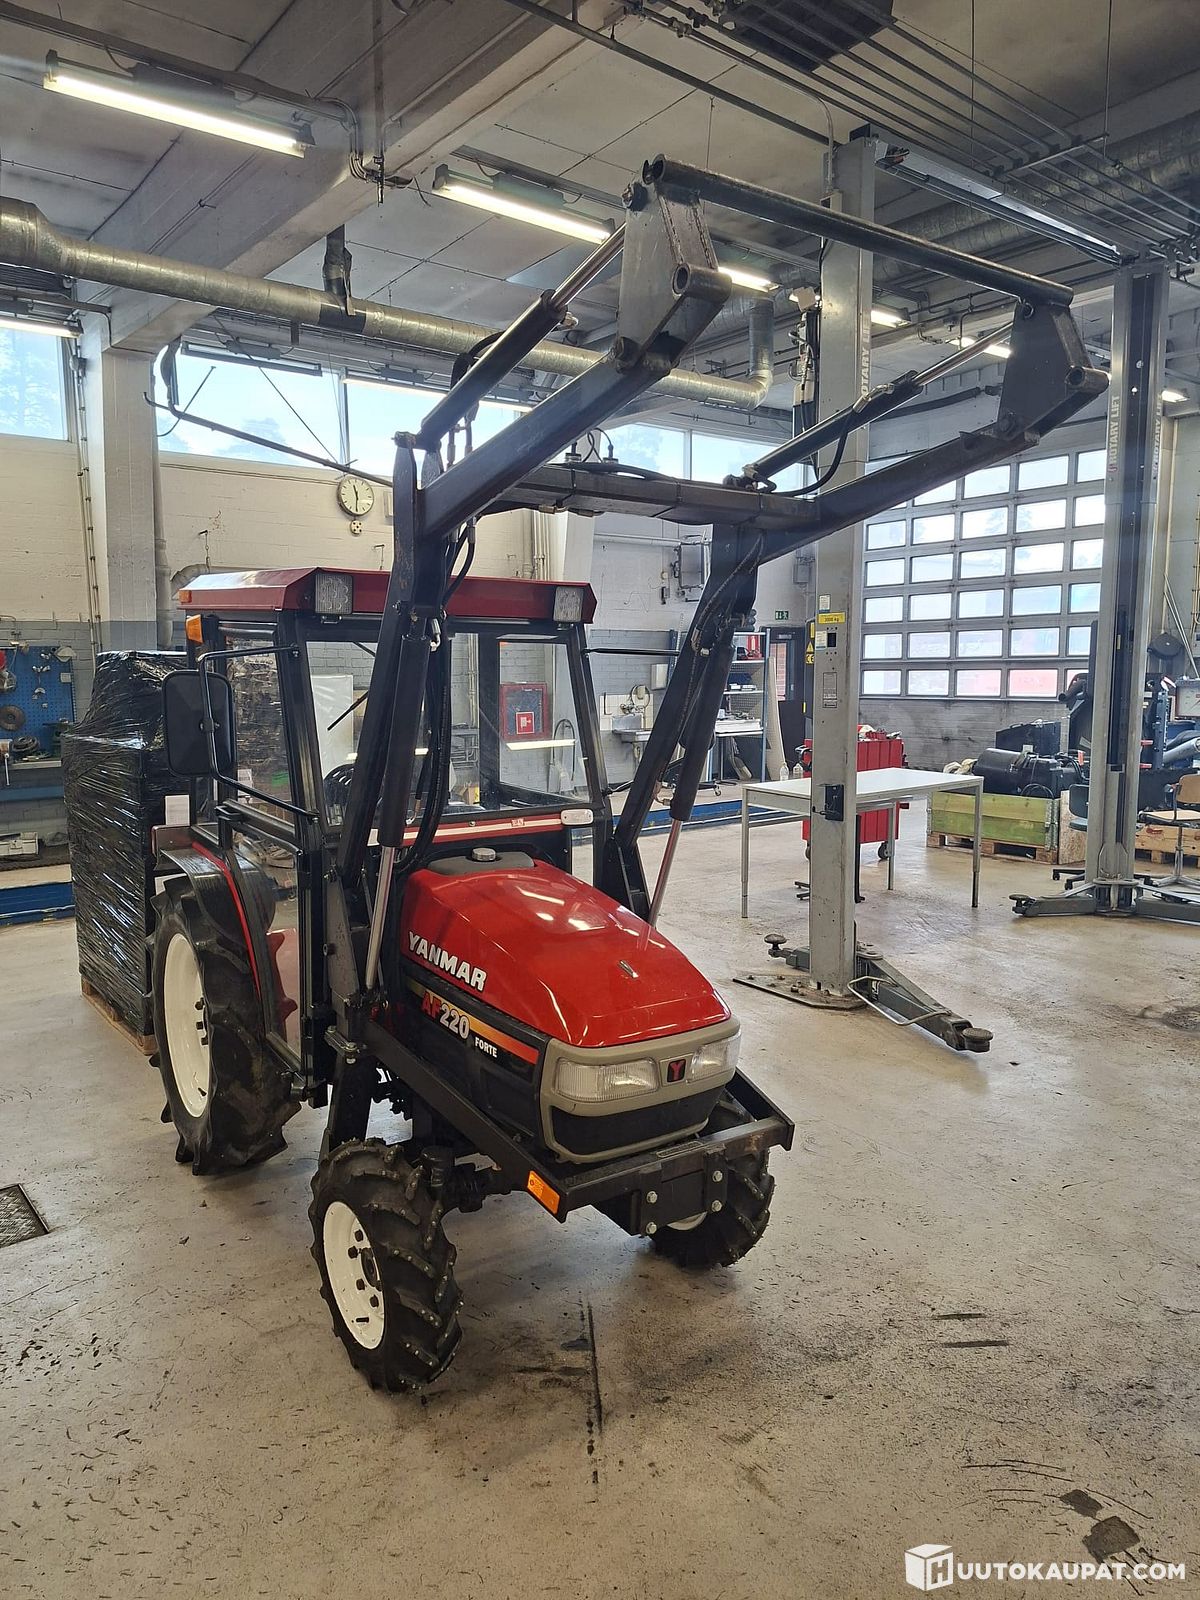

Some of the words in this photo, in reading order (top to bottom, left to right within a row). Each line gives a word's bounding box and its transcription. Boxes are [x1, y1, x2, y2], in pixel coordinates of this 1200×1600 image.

[861, 347, 870, 397] OTARY
[1111, 395, 1120, 417] LIFT
[1109, 421, 1119, 465] ROTARY
[409, 931, 487, 991] YANMAR
[422, 992, 470, 1039] AF220
[475, 1037, 498, 1058] FORTE
